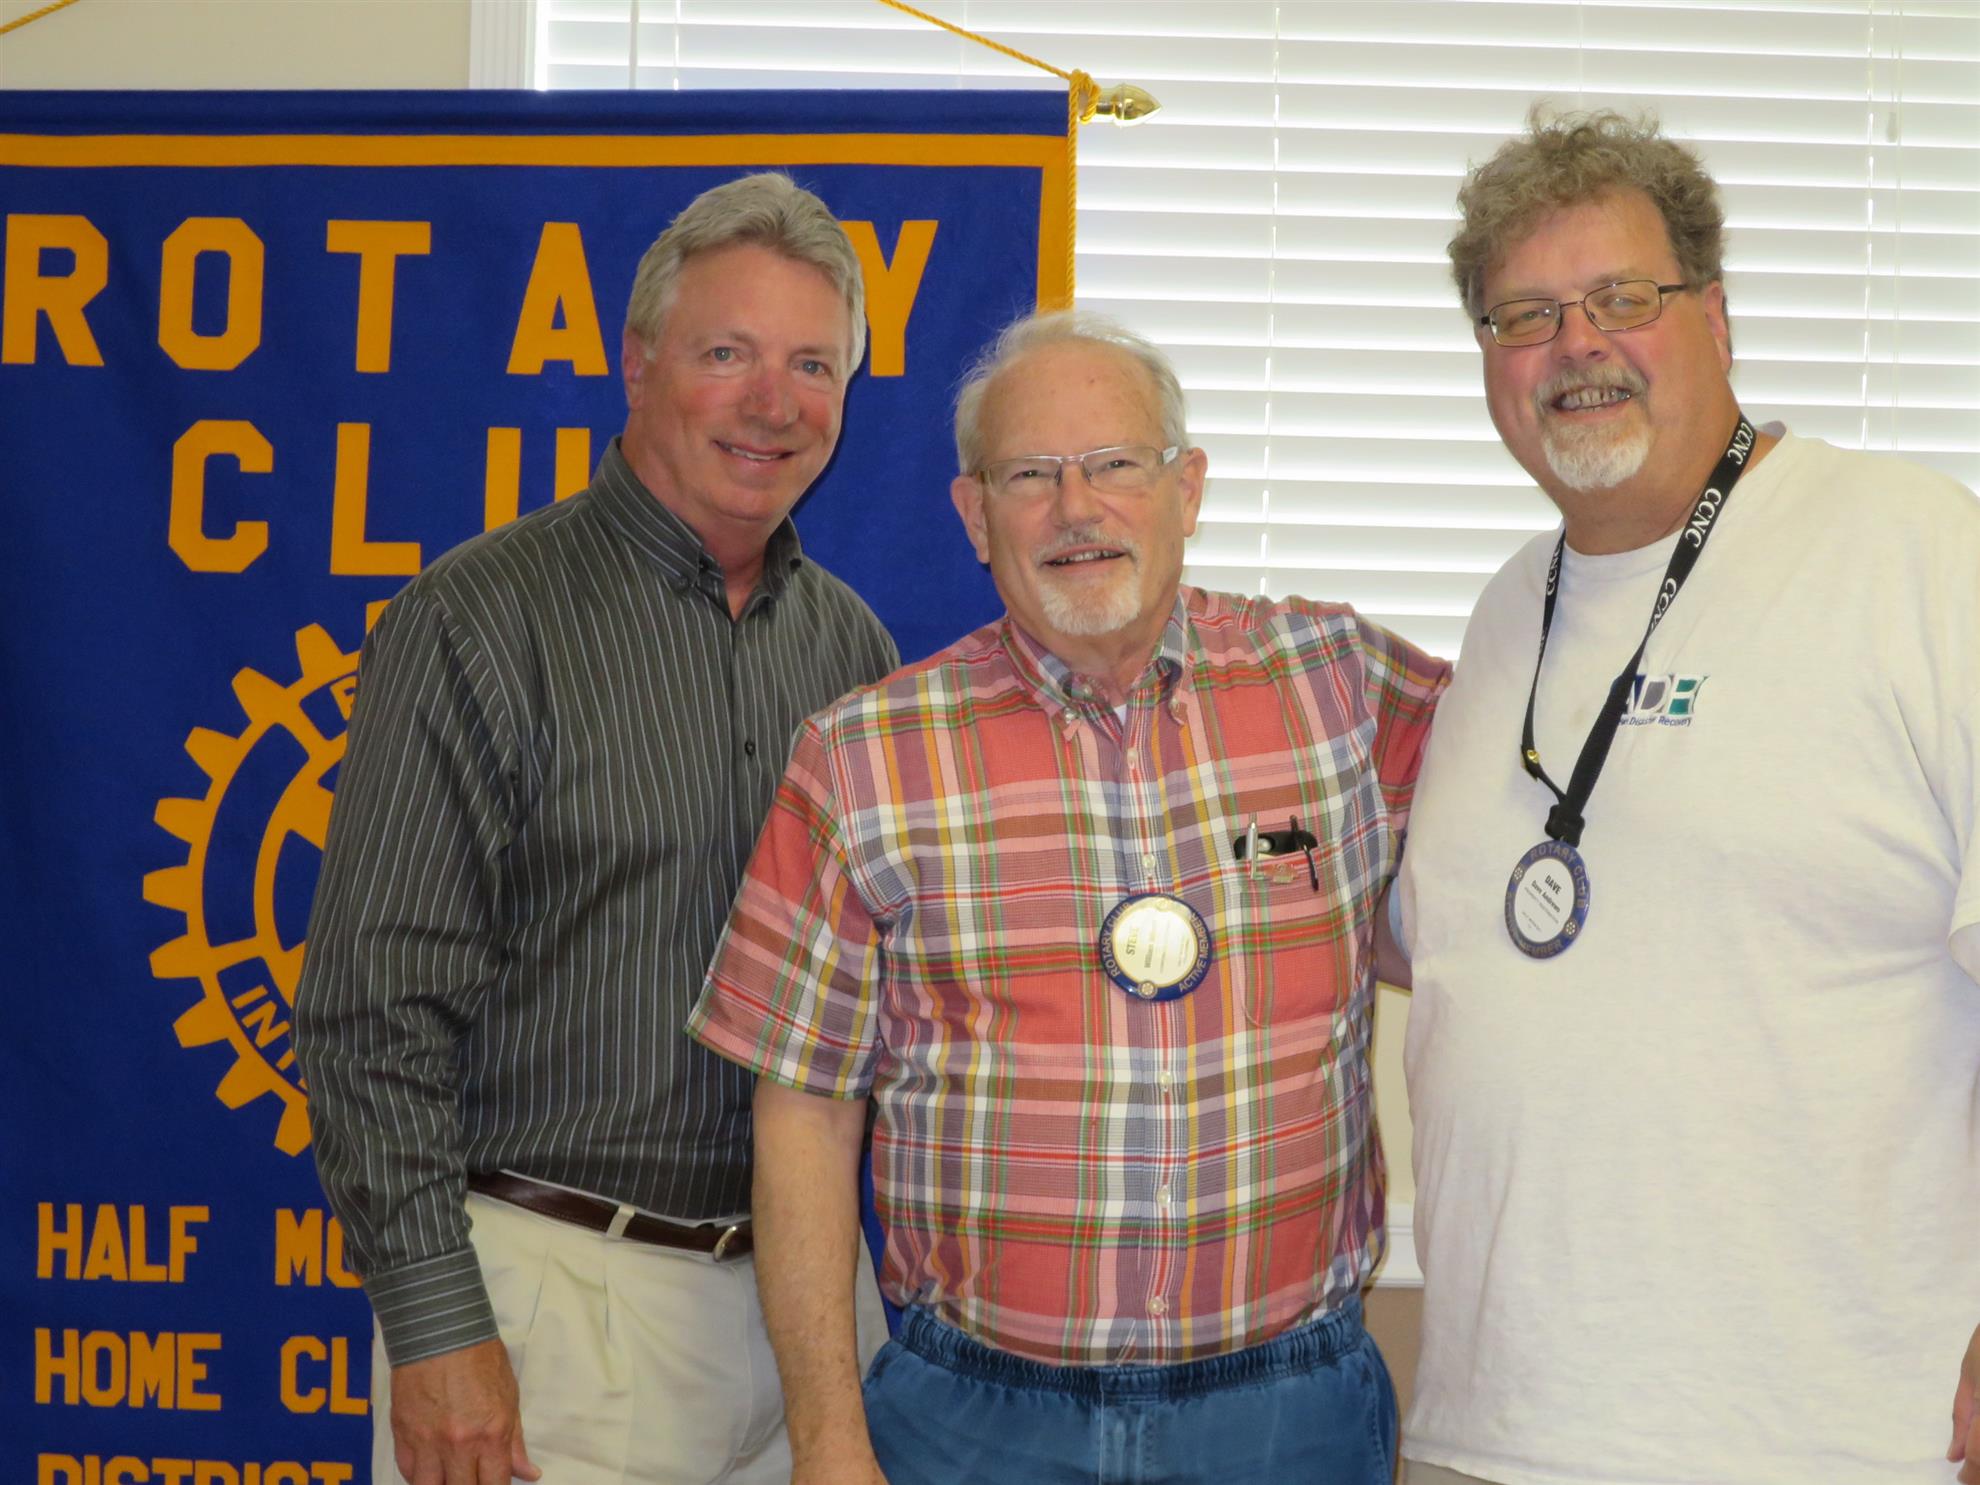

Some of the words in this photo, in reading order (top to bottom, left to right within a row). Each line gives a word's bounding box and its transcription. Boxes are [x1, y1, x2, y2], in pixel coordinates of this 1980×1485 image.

[1, 214, 938, 377] ROTAY
[1727, 422, 1753, 465] CCNC
[1685, 487, 1722, 548] CCNC
[1650, 577, 1677, 631] CCN
[1530, 844, 1577, 864] ROTARY
[1544, 875, 1562, 896] DAVE
[1102, 929, 1120, 977] ROTARY
[1190, 912, 1209, 959] MEMBER
[1178, 961, 1207, 993] ACTIVE
[37, 1202, 209, 1283] HALF
[35, 1328, 222, 1411] HOME
